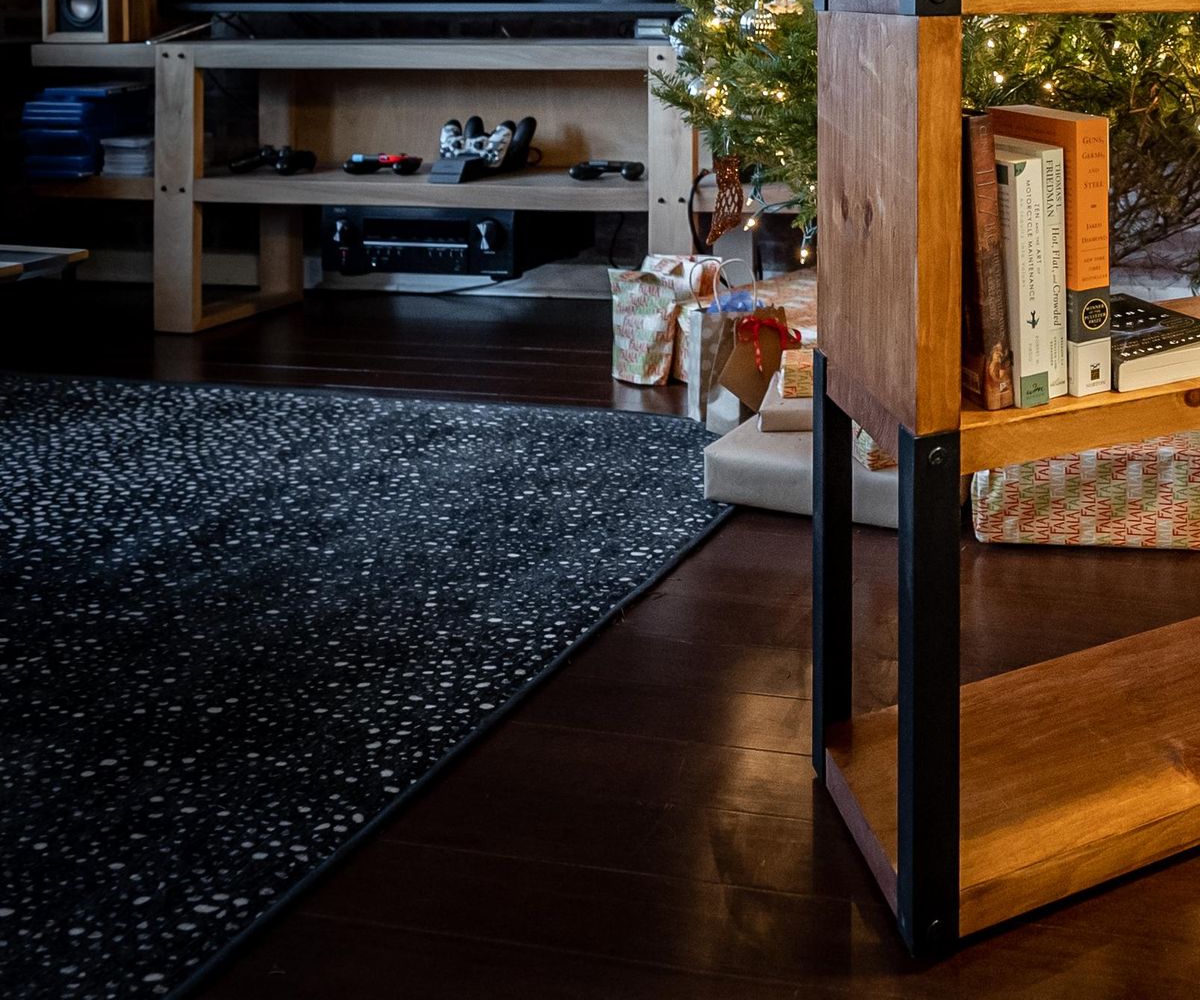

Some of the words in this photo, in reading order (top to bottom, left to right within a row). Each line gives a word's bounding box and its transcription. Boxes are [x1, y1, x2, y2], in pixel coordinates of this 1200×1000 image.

[1082, 135, 1104, 144] GUNS,
[976, 168, 998, 217] 1177
[1046, 159, 1055, 218] FRIEDMAN
[1083, 180, 1104, 189] STEEL
[1025, 179, 1033, 238] MOTORCYCLE
[1051, 227, 1060, 248] Hot,
[1027, 240, 1035, 301] MAINTENANCE
[1051, 250, 1061, 273] Flat,
[1052, 284, 1062, 327] Crowded
[1004, 481, 1019, 516] FALALA
[1020, 498, 1034, 532] FALALA
[1050, 498, 1065, 534] FALALA
[1081, 481, 1096, 517] FALALA
[1096, 499, 1111, 533] FALALA
[1158, 482, 1173, 519] FALALA
[1127, 499, 1142, 535] FALALA
[1173, 502, 1188, 536] FALALA
